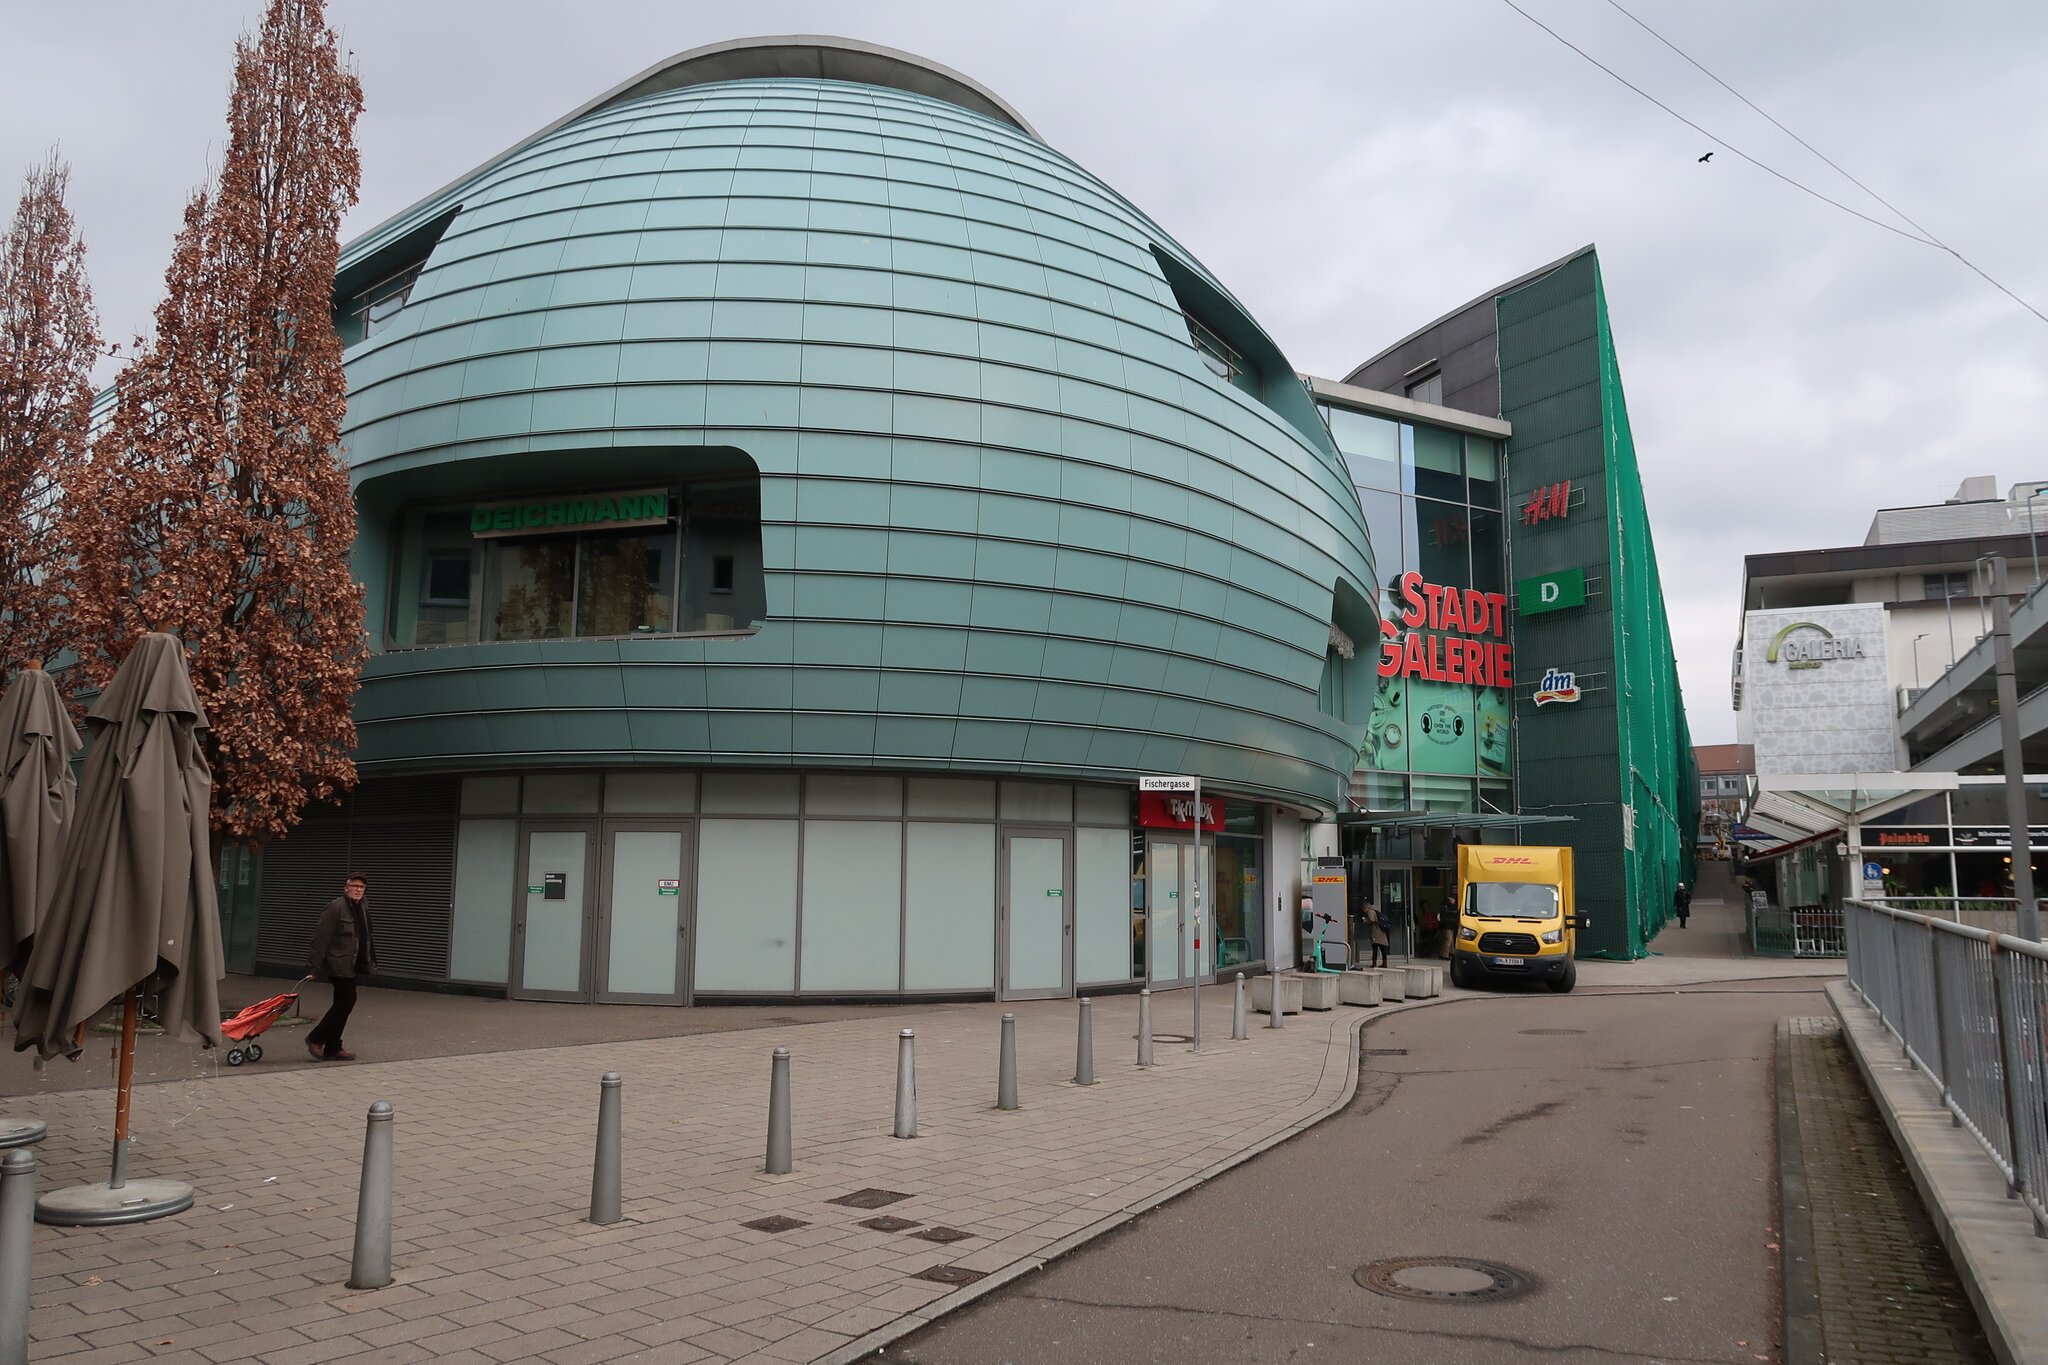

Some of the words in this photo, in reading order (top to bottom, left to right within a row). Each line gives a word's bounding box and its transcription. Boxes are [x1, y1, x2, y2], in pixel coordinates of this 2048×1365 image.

[471, 494, 666, 532] DEICHMANN
[1523, 480, 1571, 525] H&M
[1541, 582, 1559, 602] D
[1401, 571, 1507, 637] STADT
[1377, 619, 1513, 688] GALERIE
[1785, 638, 1865, 661] GALERIA
[1543, 671, 1571, 691] dm
[1144, 780, 1190, 789] Fischergasse
[1492, 857, 1531, 865] DHL
